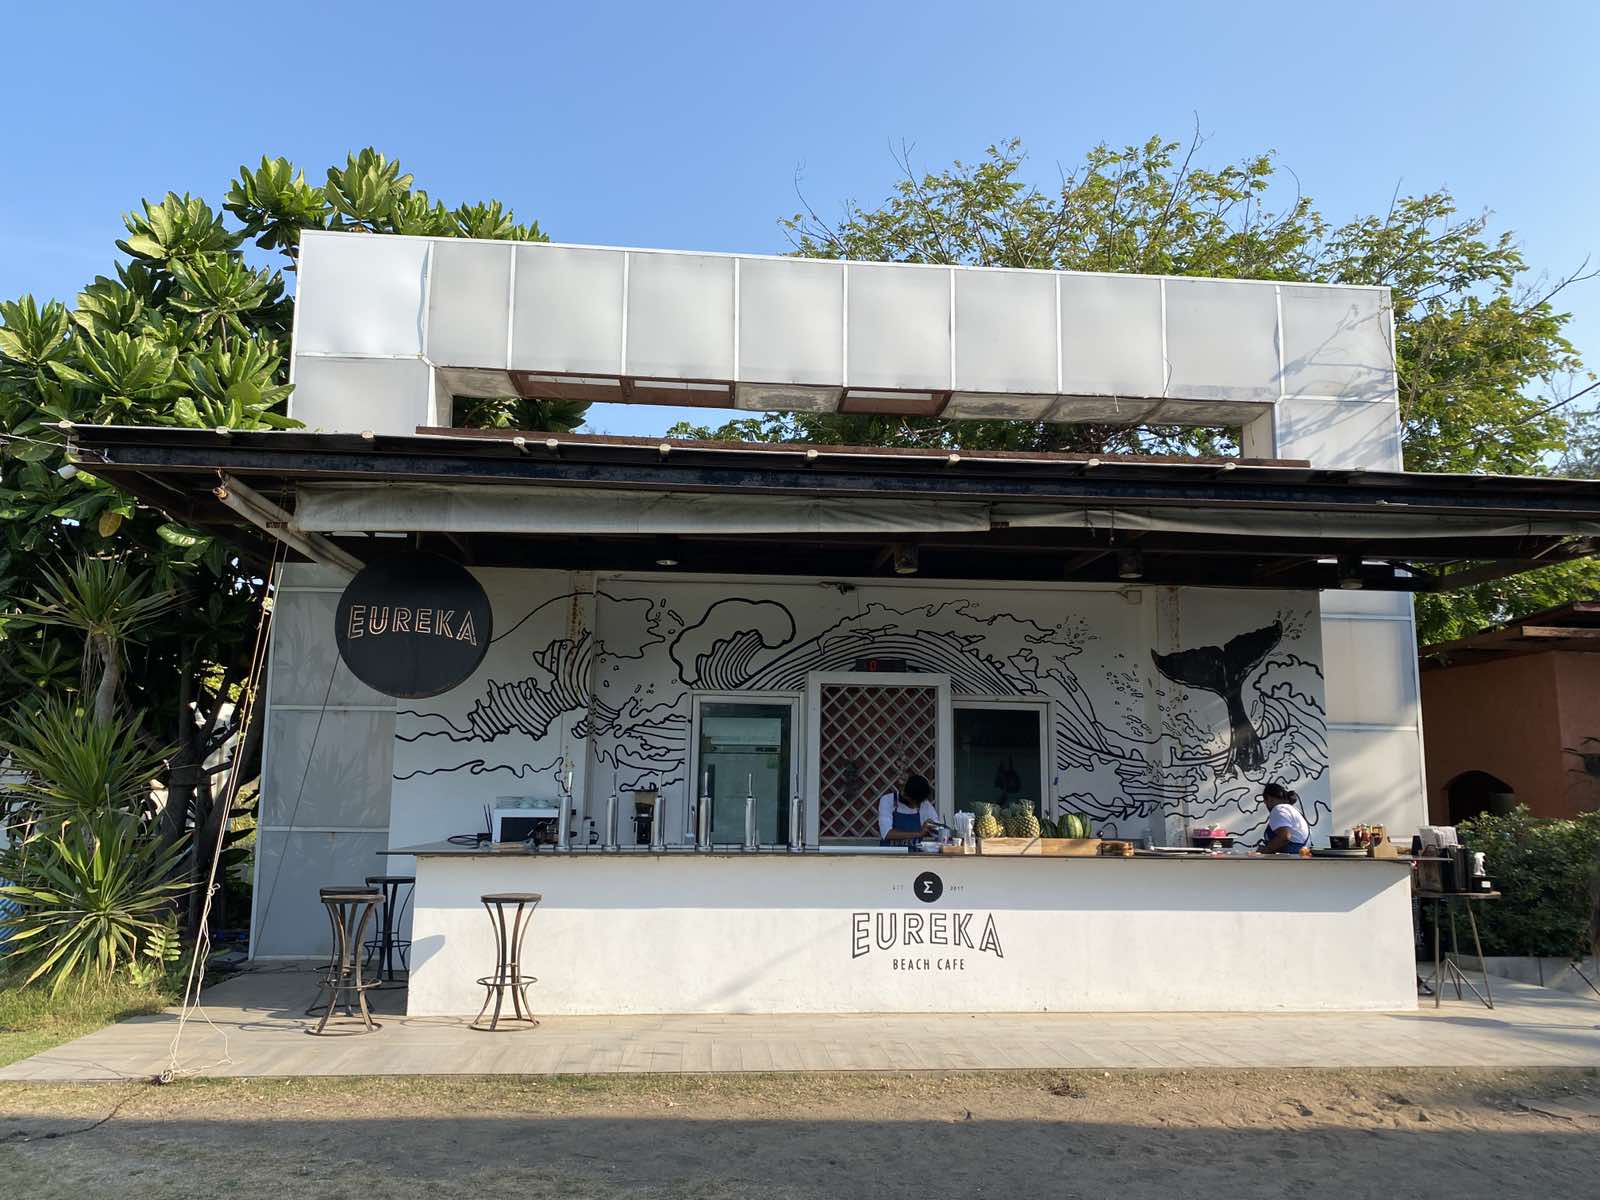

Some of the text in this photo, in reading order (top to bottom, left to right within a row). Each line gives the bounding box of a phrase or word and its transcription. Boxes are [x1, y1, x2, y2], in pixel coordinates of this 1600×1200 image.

[347, 604, 477, 646] EUREKA
[852, 912, 1004, 959] EUREKA
[893, 959, 965, 970] BEACH CAFE
